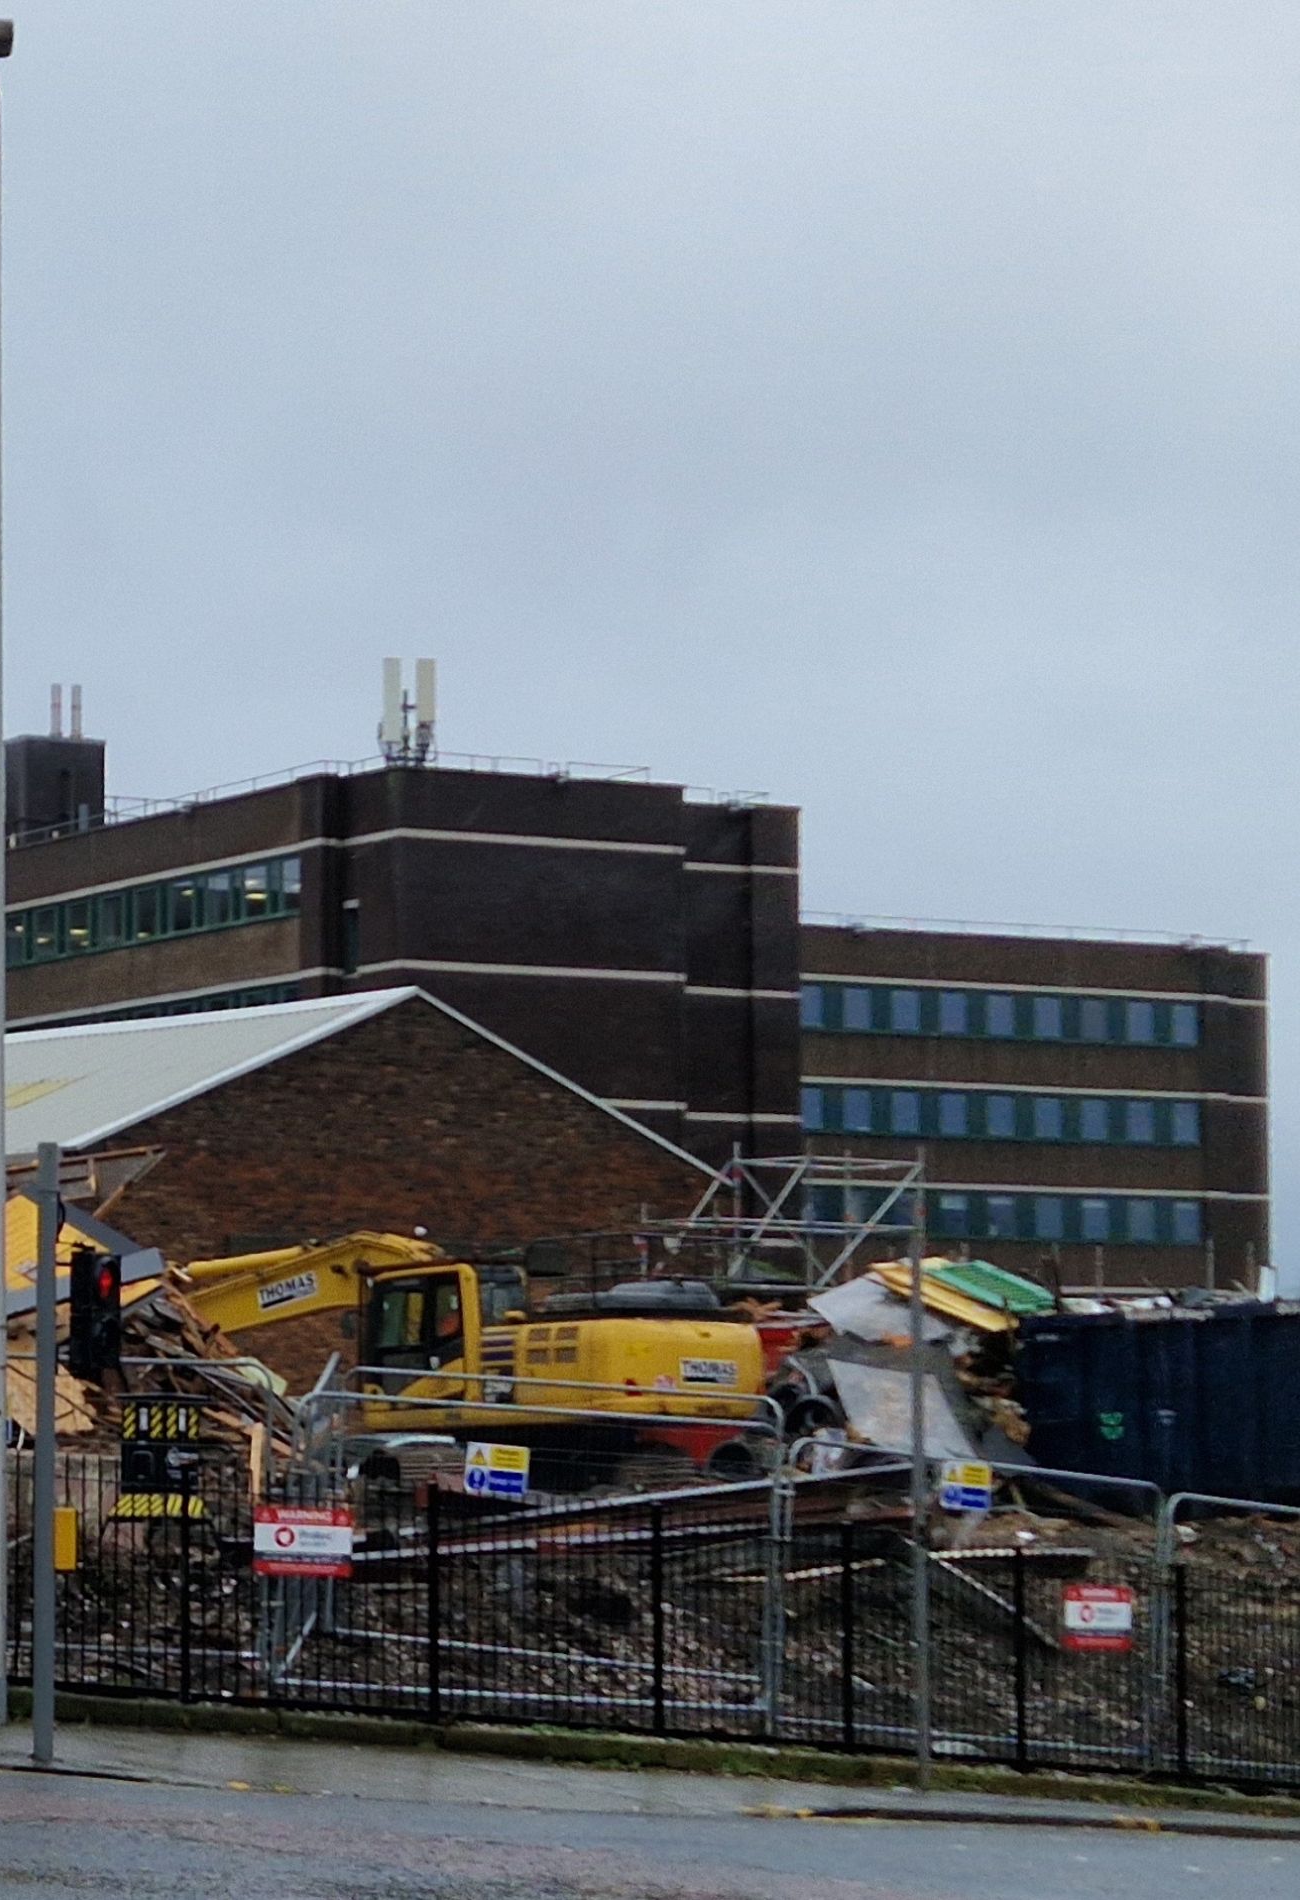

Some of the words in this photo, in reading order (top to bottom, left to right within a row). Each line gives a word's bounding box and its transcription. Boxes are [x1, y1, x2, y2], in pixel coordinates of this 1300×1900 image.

[259, 1272, 315, 1301] THOMAS
[683, 1360, 737, 1376] THOMAS
[276, 1508, 333, 1521] WARNING
